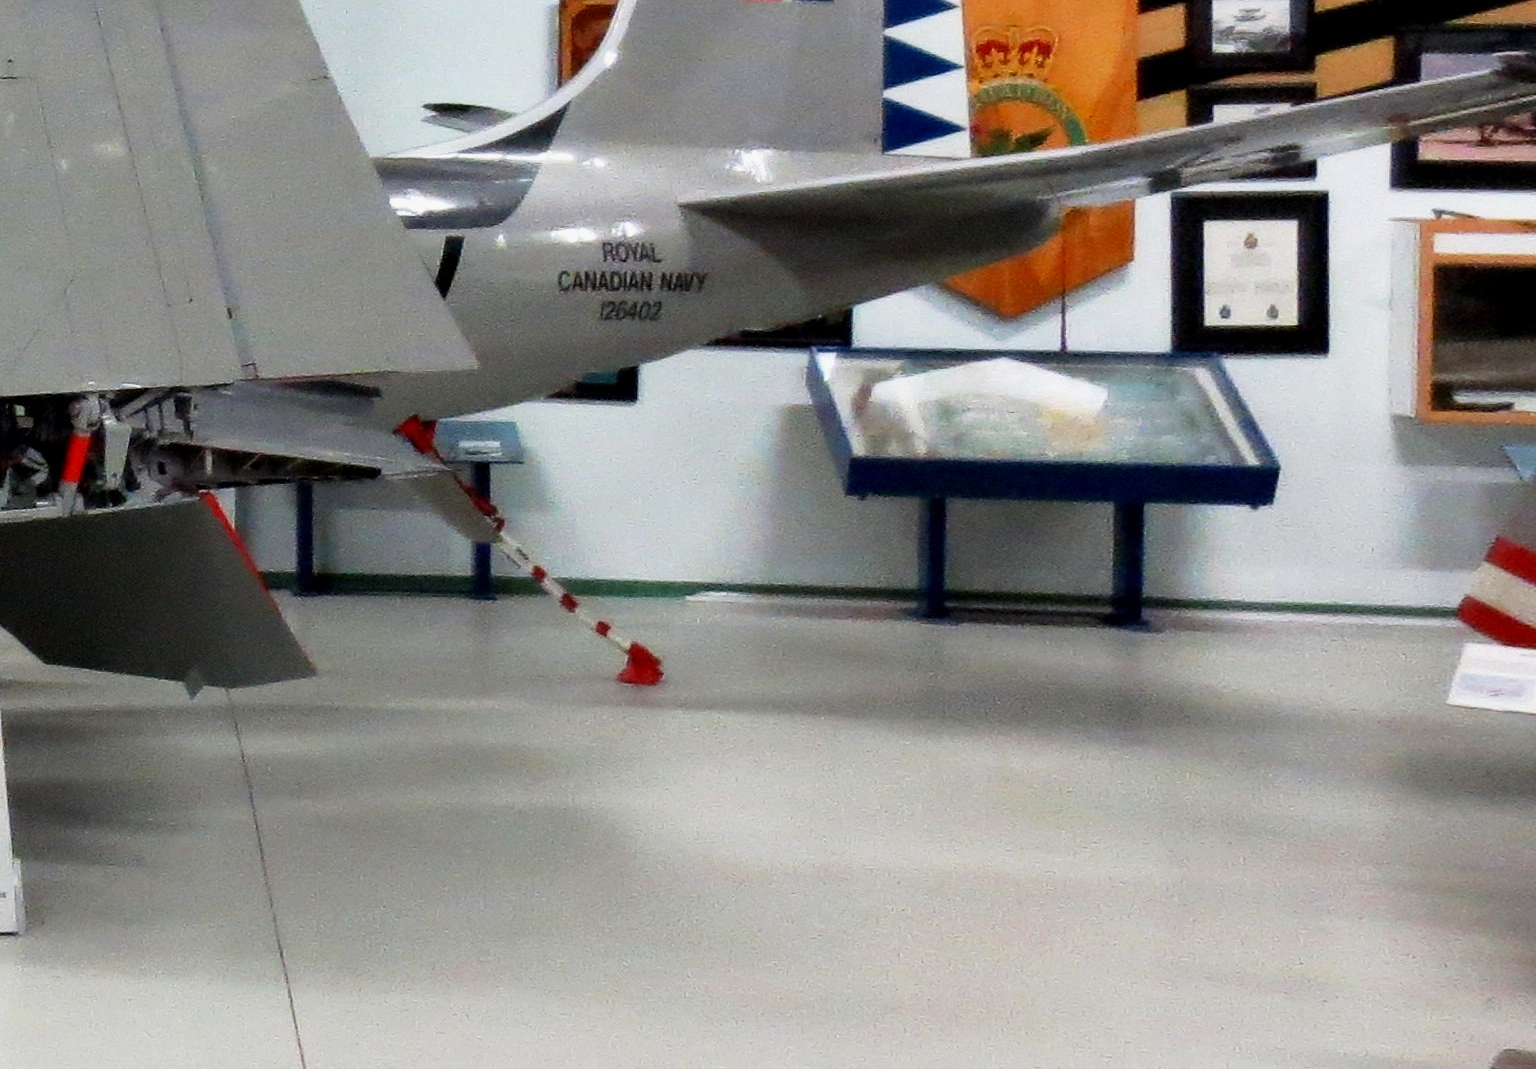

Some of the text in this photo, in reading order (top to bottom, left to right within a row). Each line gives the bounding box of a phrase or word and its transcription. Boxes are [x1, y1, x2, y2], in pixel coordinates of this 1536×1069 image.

[602, 242, 663, 264] ROYAL
[557, 269, 710, 292] CANADIAN NAVY
[599, 300, 663, 322] 126402
